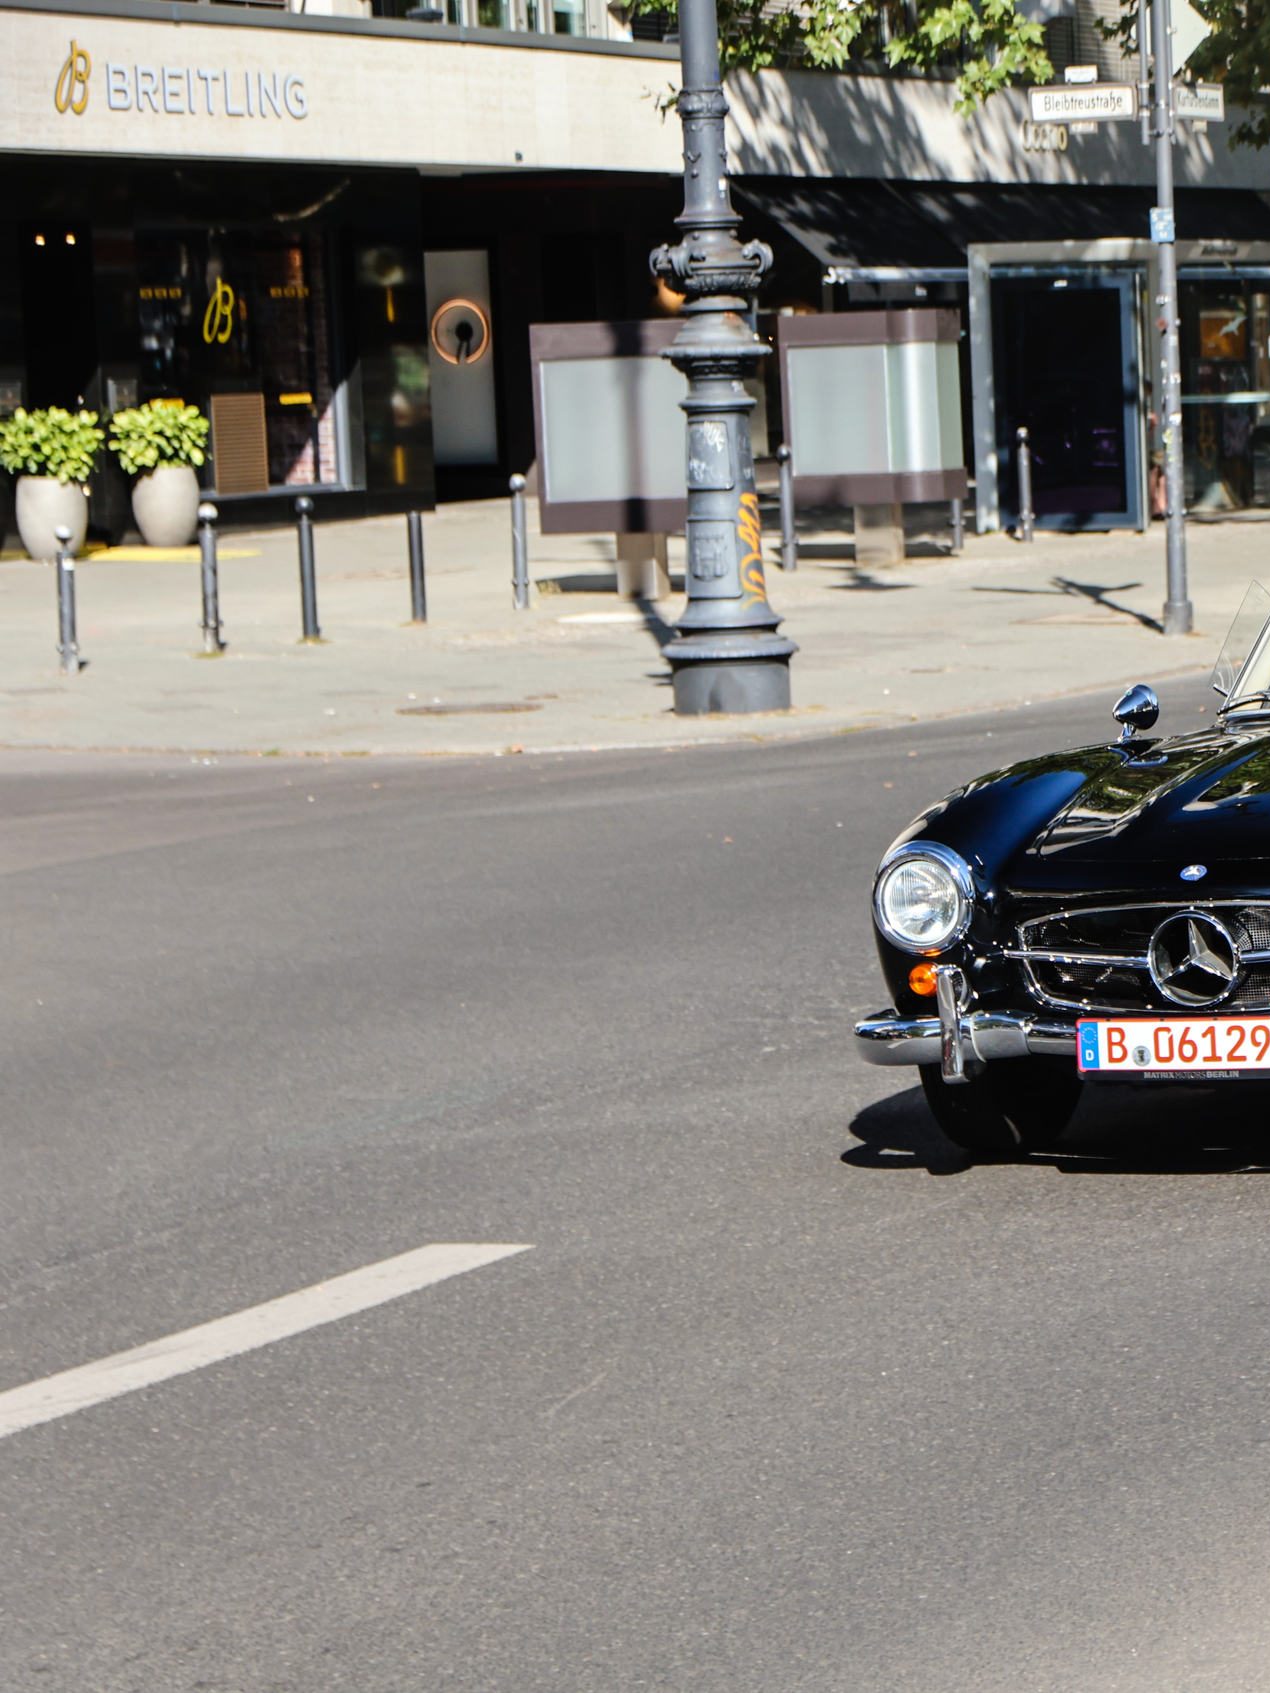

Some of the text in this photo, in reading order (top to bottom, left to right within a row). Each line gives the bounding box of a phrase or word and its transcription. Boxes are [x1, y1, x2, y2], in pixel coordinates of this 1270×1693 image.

[106, 62, 308, 120] BREITLING
[1044, 91, 1123, 112] Bleibtreustraße
[1085, 1049, 1095, 1061] D
[1106, 1027, 1128, 1064] B
